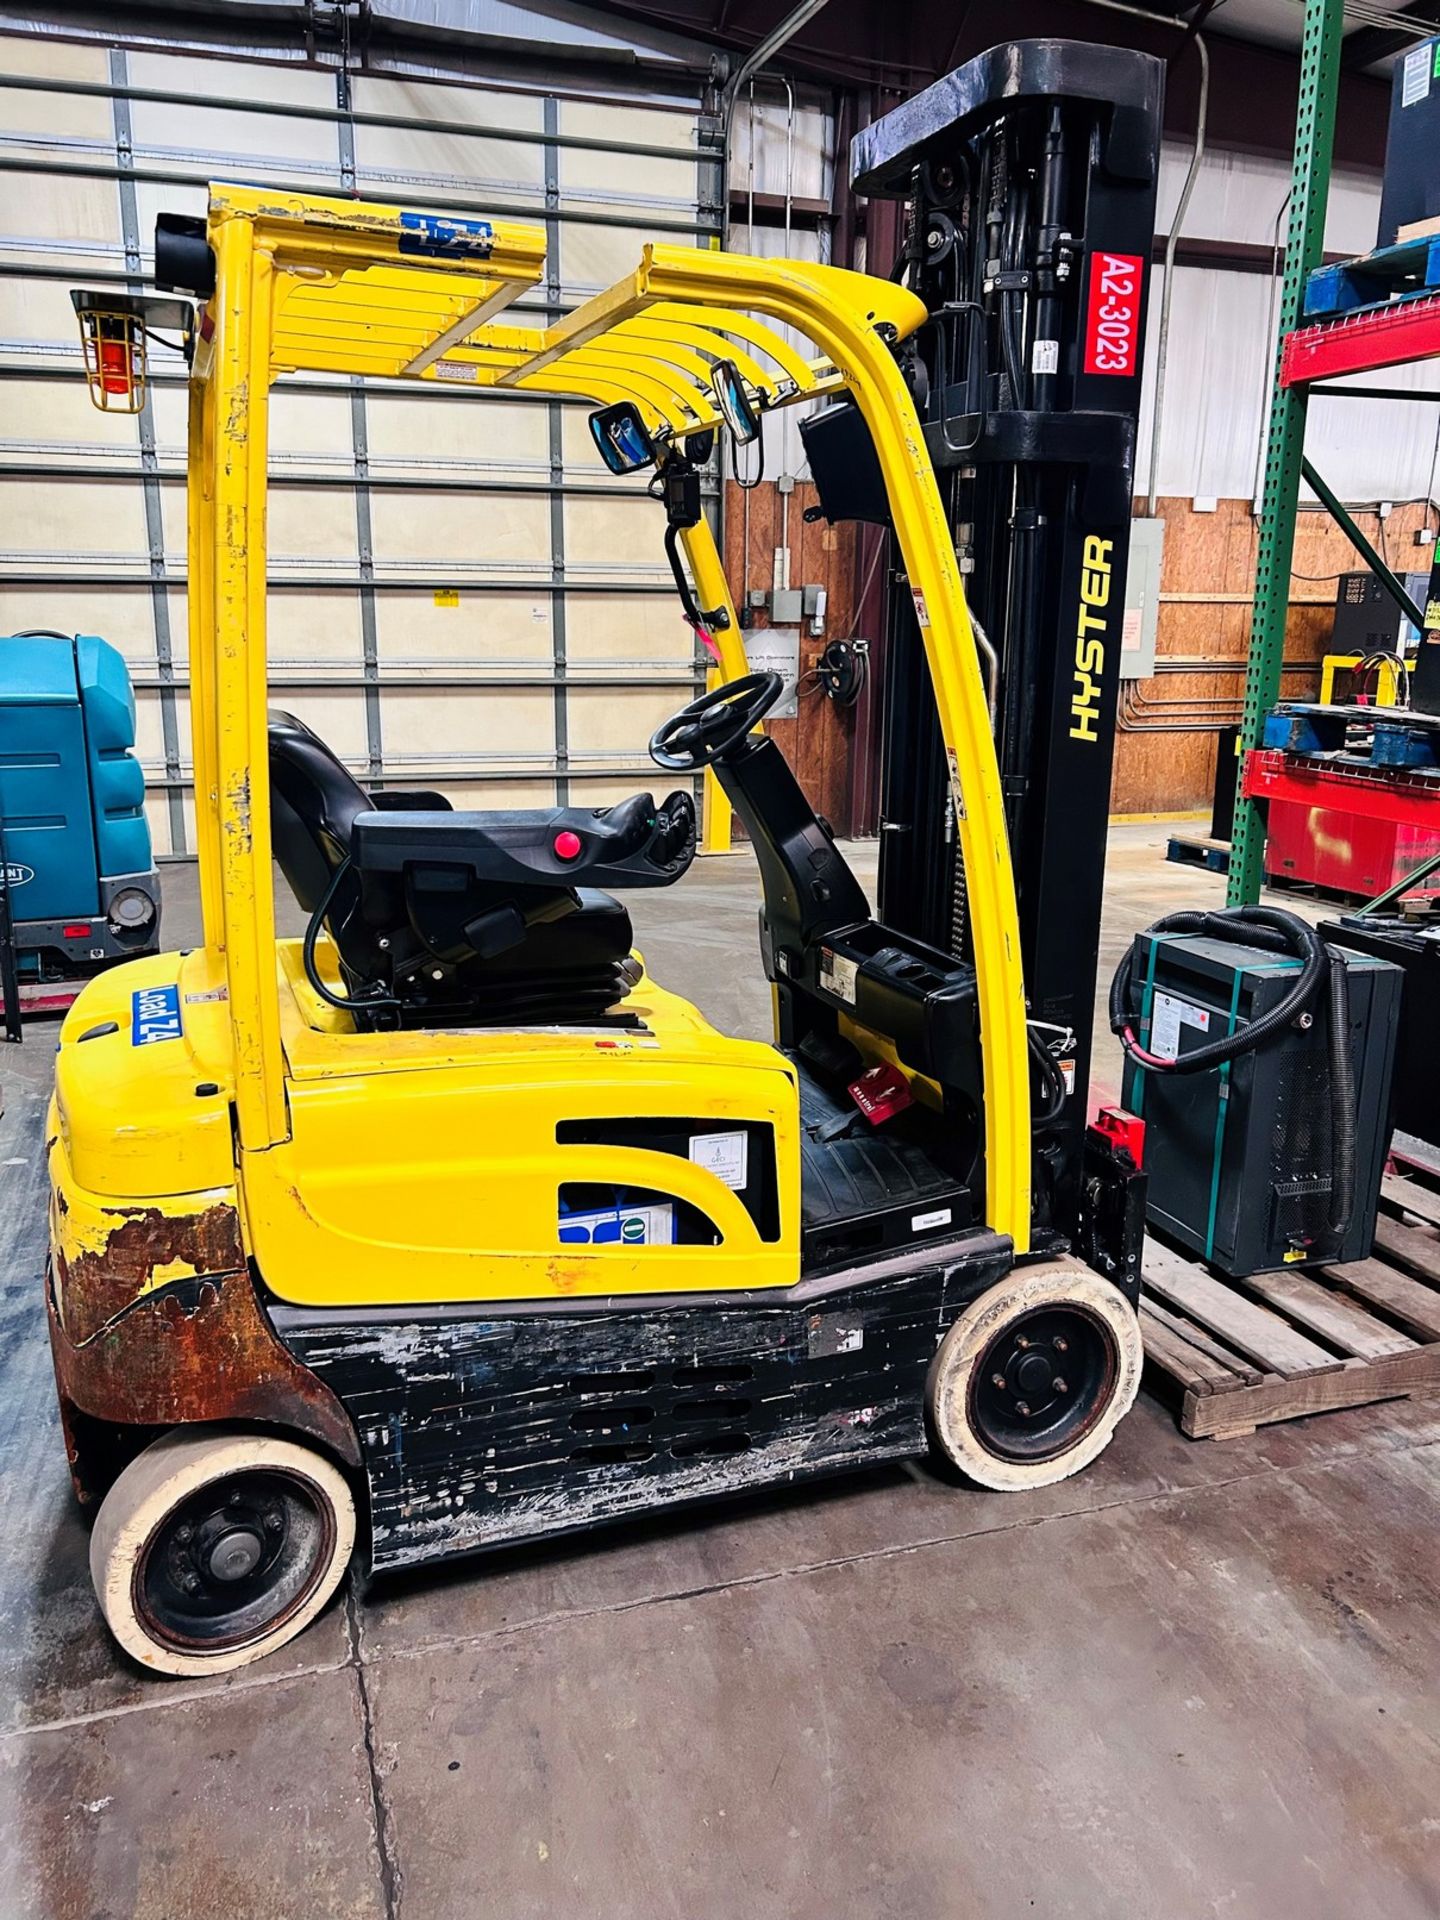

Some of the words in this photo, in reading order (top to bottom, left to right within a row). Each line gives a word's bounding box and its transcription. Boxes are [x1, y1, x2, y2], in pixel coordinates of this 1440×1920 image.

[1095, 255, 1135, 370] A2-3023
[1069, 535, 1114, 742] HYSTER
[139, 985, 177, 1021] Load
[139, 1018, 181, 1044] Z4
